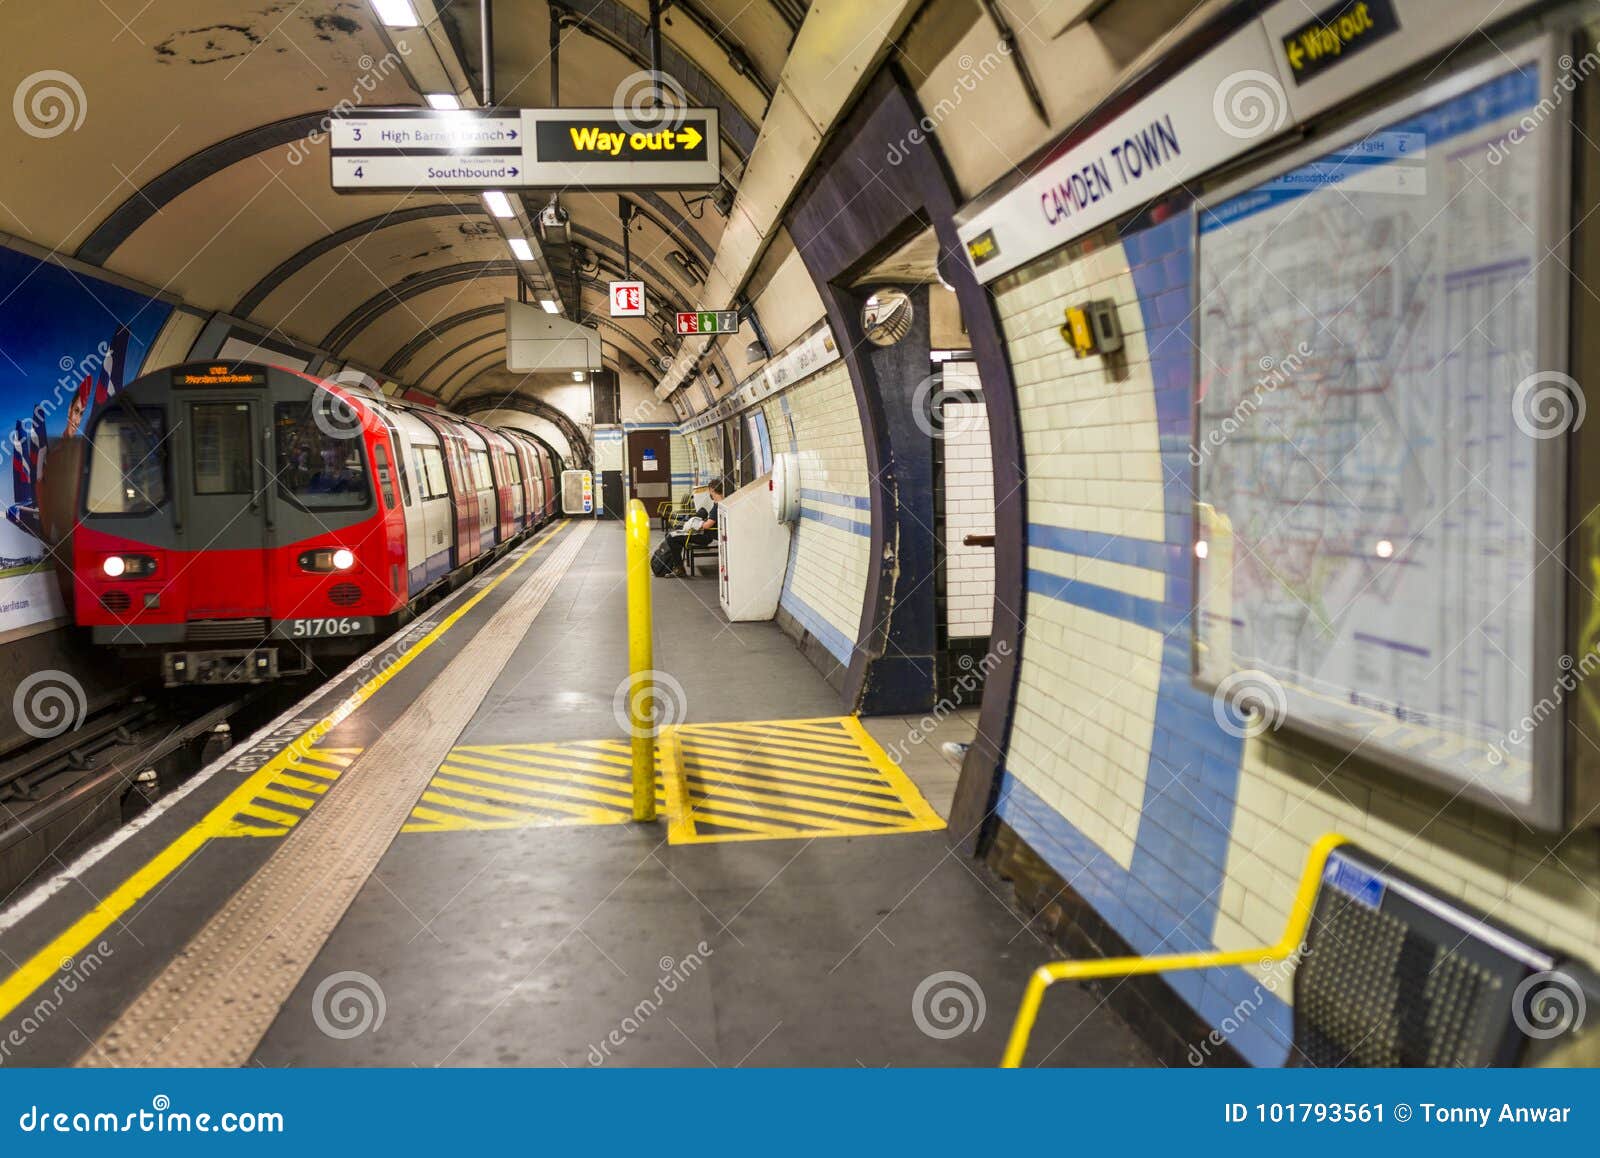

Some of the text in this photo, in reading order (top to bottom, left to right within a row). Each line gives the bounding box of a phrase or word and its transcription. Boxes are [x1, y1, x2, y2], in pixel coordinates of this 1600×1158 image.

[353, 128, 362, 141] 3
[381, 130, 410, 143] High
[570, 127, 675, 155] Way out
[354, 166, 363, 178] 4
[428, 167, 505, 178] Southbound
[1041, 113, 1181, 225] CAMDEN TOWN
[293, 618, 351, 636] 51706
